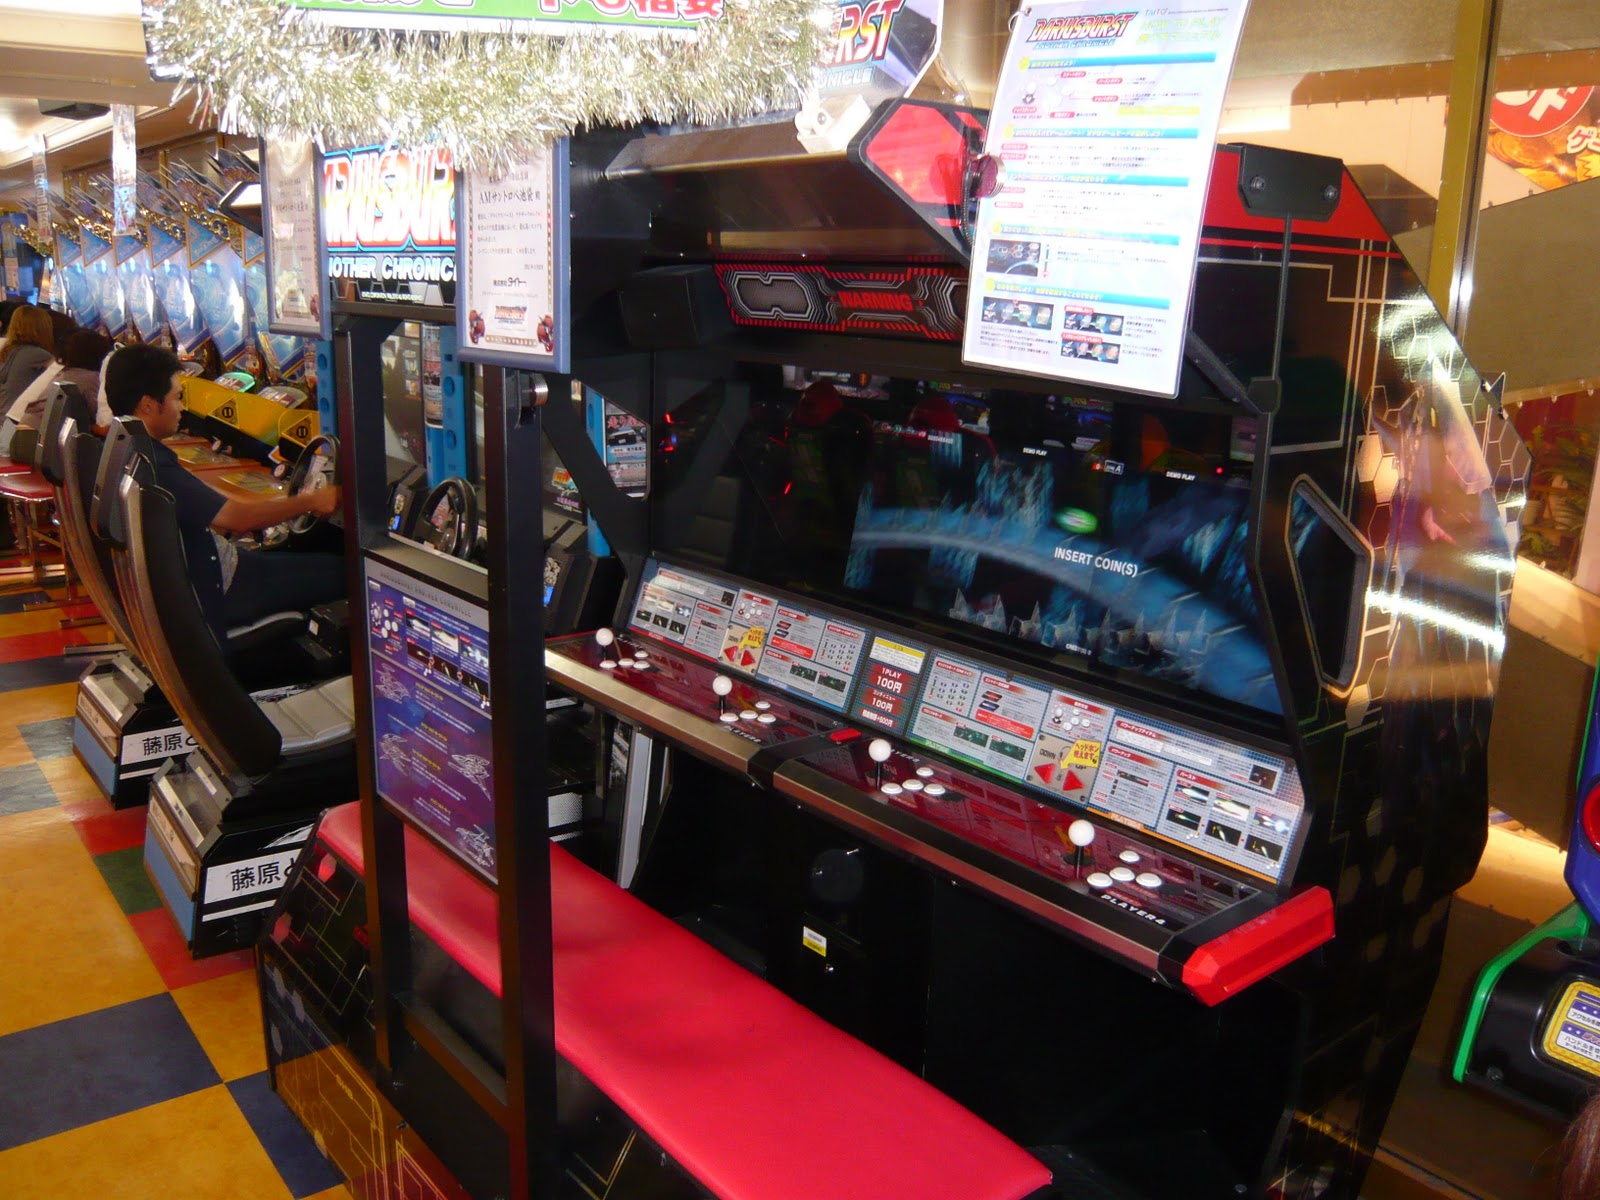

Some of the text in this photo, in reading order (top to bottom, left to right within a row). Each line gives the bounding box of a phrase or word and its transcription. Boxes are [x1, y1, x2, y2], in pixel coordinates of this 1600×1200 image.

[1144, 8, 1168, 16] TAITO
[833, 0, 903, 62] RST
[1026, 12, 1139, 42] DARIUSBURST
[1033, 38, 1116, 50] ANOTHER CHRONICLE
[382, 256, 457, 281] CHRONIC
[837, 291, 914, 311] WARNING
[1036, 449, 1047, 457] PLAY
[1166, 471, 1195, 481] DEMO PLAY
[1054, 547, 1138, 578] INSERT COIN(S)
[877, 676, 902, 693] 100円
[872, 698, 893, 713] 100円
[1040, 748, 1056, 760] DOWN
[1074, 742, 1100, 753] ヘッドホン
[1180, 771, 1197, 781] バースト
